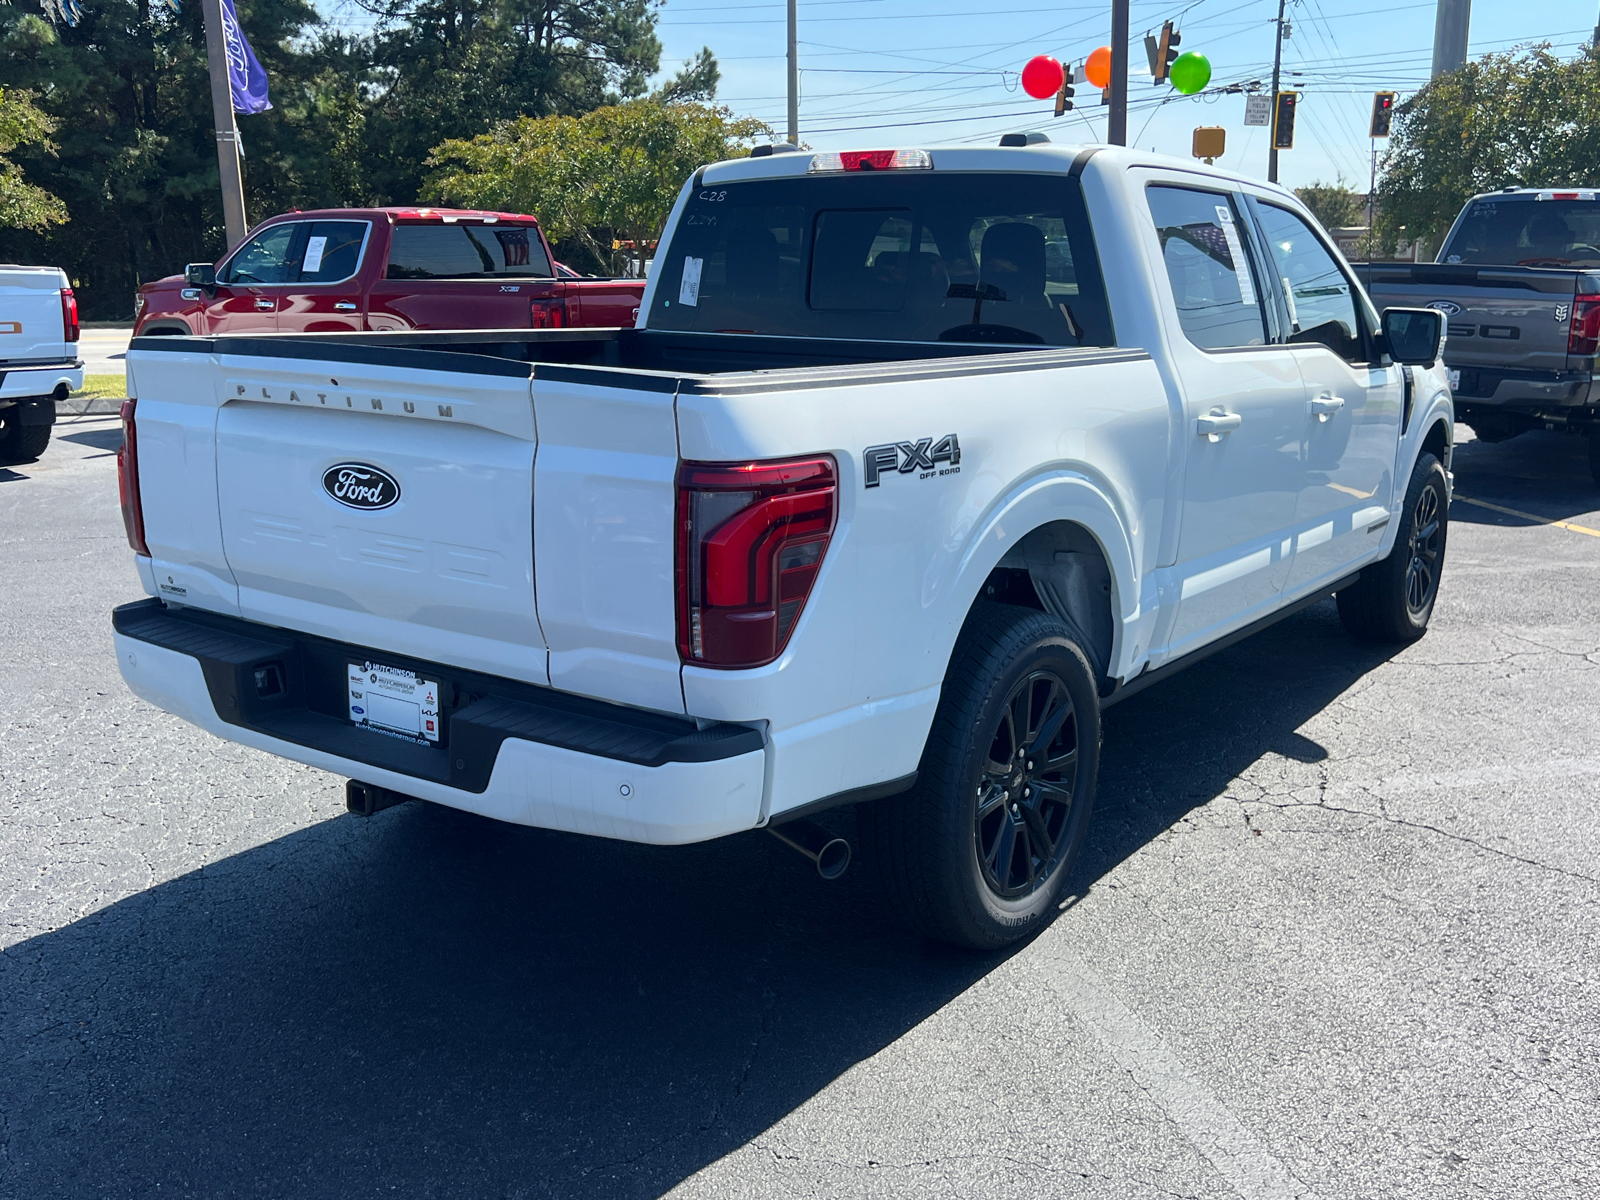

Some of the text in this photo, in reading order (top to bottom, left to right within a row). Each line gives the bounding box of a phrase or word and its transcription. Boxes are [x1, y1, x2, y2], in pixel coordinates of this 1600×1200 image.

[699, 190, 728, 202] C28
[236, 384, 453, 418] PLATINUM
[863, 433, 961, 490] FX4
[920, 466, 961, 480] OFF ROAD
[331, 468, 387, 504] Ford
[160, 583, 187, 593] HUTCHINSON
[373, 663, 416, 679] HUTCHINSON
[378, 676, 416, 691] HUTCHINSON
